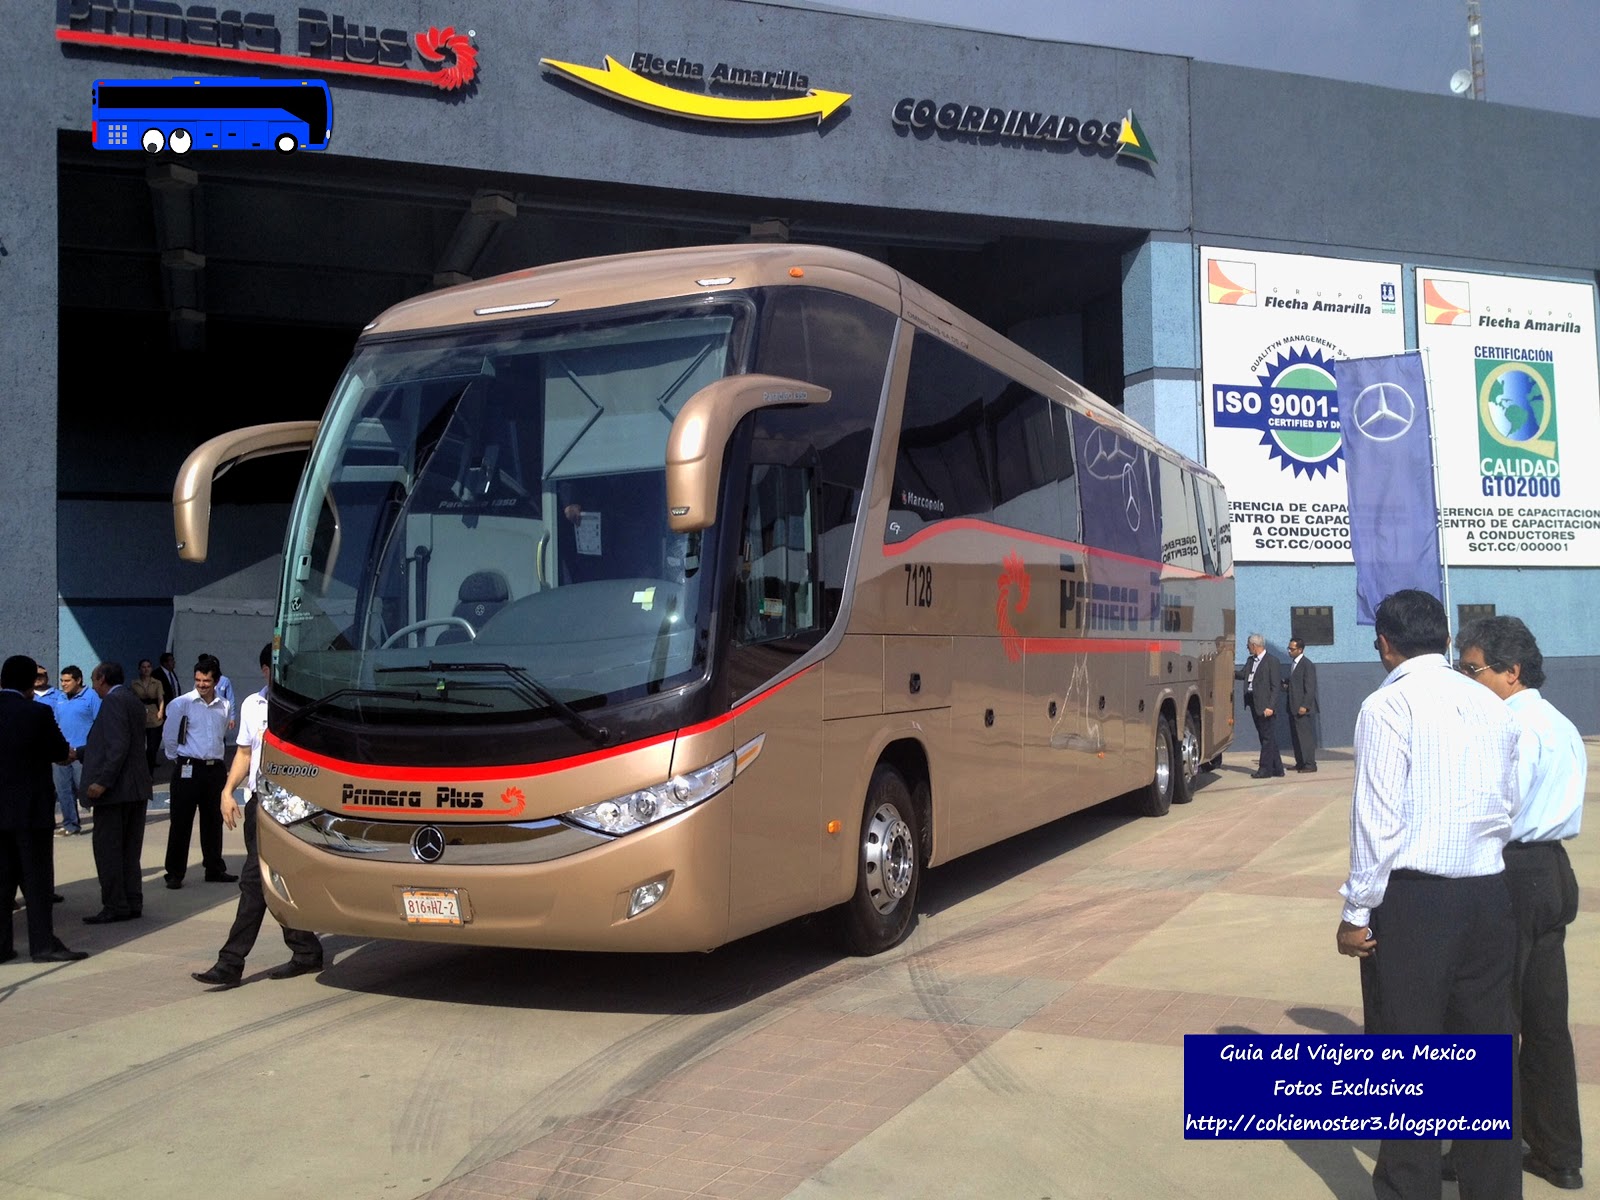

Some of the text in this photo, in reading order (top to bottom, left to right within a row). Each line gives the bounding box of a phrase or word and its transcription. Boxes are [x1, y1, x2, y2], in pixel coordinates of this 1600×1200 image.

[298, 8, 408, 66] Plus
[629, 52, 809, 91] Flecha Amarilla
[892, 97, 1123, 147] COORDINADOS
[1265, 296, 1309, 310] Flecha
[1312, 300, 1372, 314] Amarilla
[1479, 315, 1581, 333] Flecha Amarilla
[1250, 340, 1282, 372] QUALITYN
[1282, 334, 1337, 351] MANAGEMENT
[1474, 344, 1553, 362] CERTIFICACIÓN
[1216, 390, 1340, 418] ISO 9001-
[1268, 418, 1315, 429] CERTIFIED
[1316, 420, 1329, 429] BY
[1480, 457, 1559, 477] CALIDAD
[1482, 475, 1561, 498] GTO2000
[1228, 501, 1349, 513] ERENCIA DE CAPA
[1442, 507, 1494, 517] ERENCIA
[1498, 508, 1515, 517] DE
[1229, 513, 1350, 525] ENTRO DE CAPAC
[1443, 519, 1486, 528] ENTRO
[1491, 519, 1508, 528] DE
[1252, 526, 1349, 537] A CONDUCTO
[1466, 531, 1576, 540] A CONDUCTORES
[1255, 539, 1352, 550] SCT.CC/0000
[1468, 542, 1569, 552] SCT.CC/000001
[905, 563, 932, 608] 7128
[342, 783, 484, 809] Primera Plus
